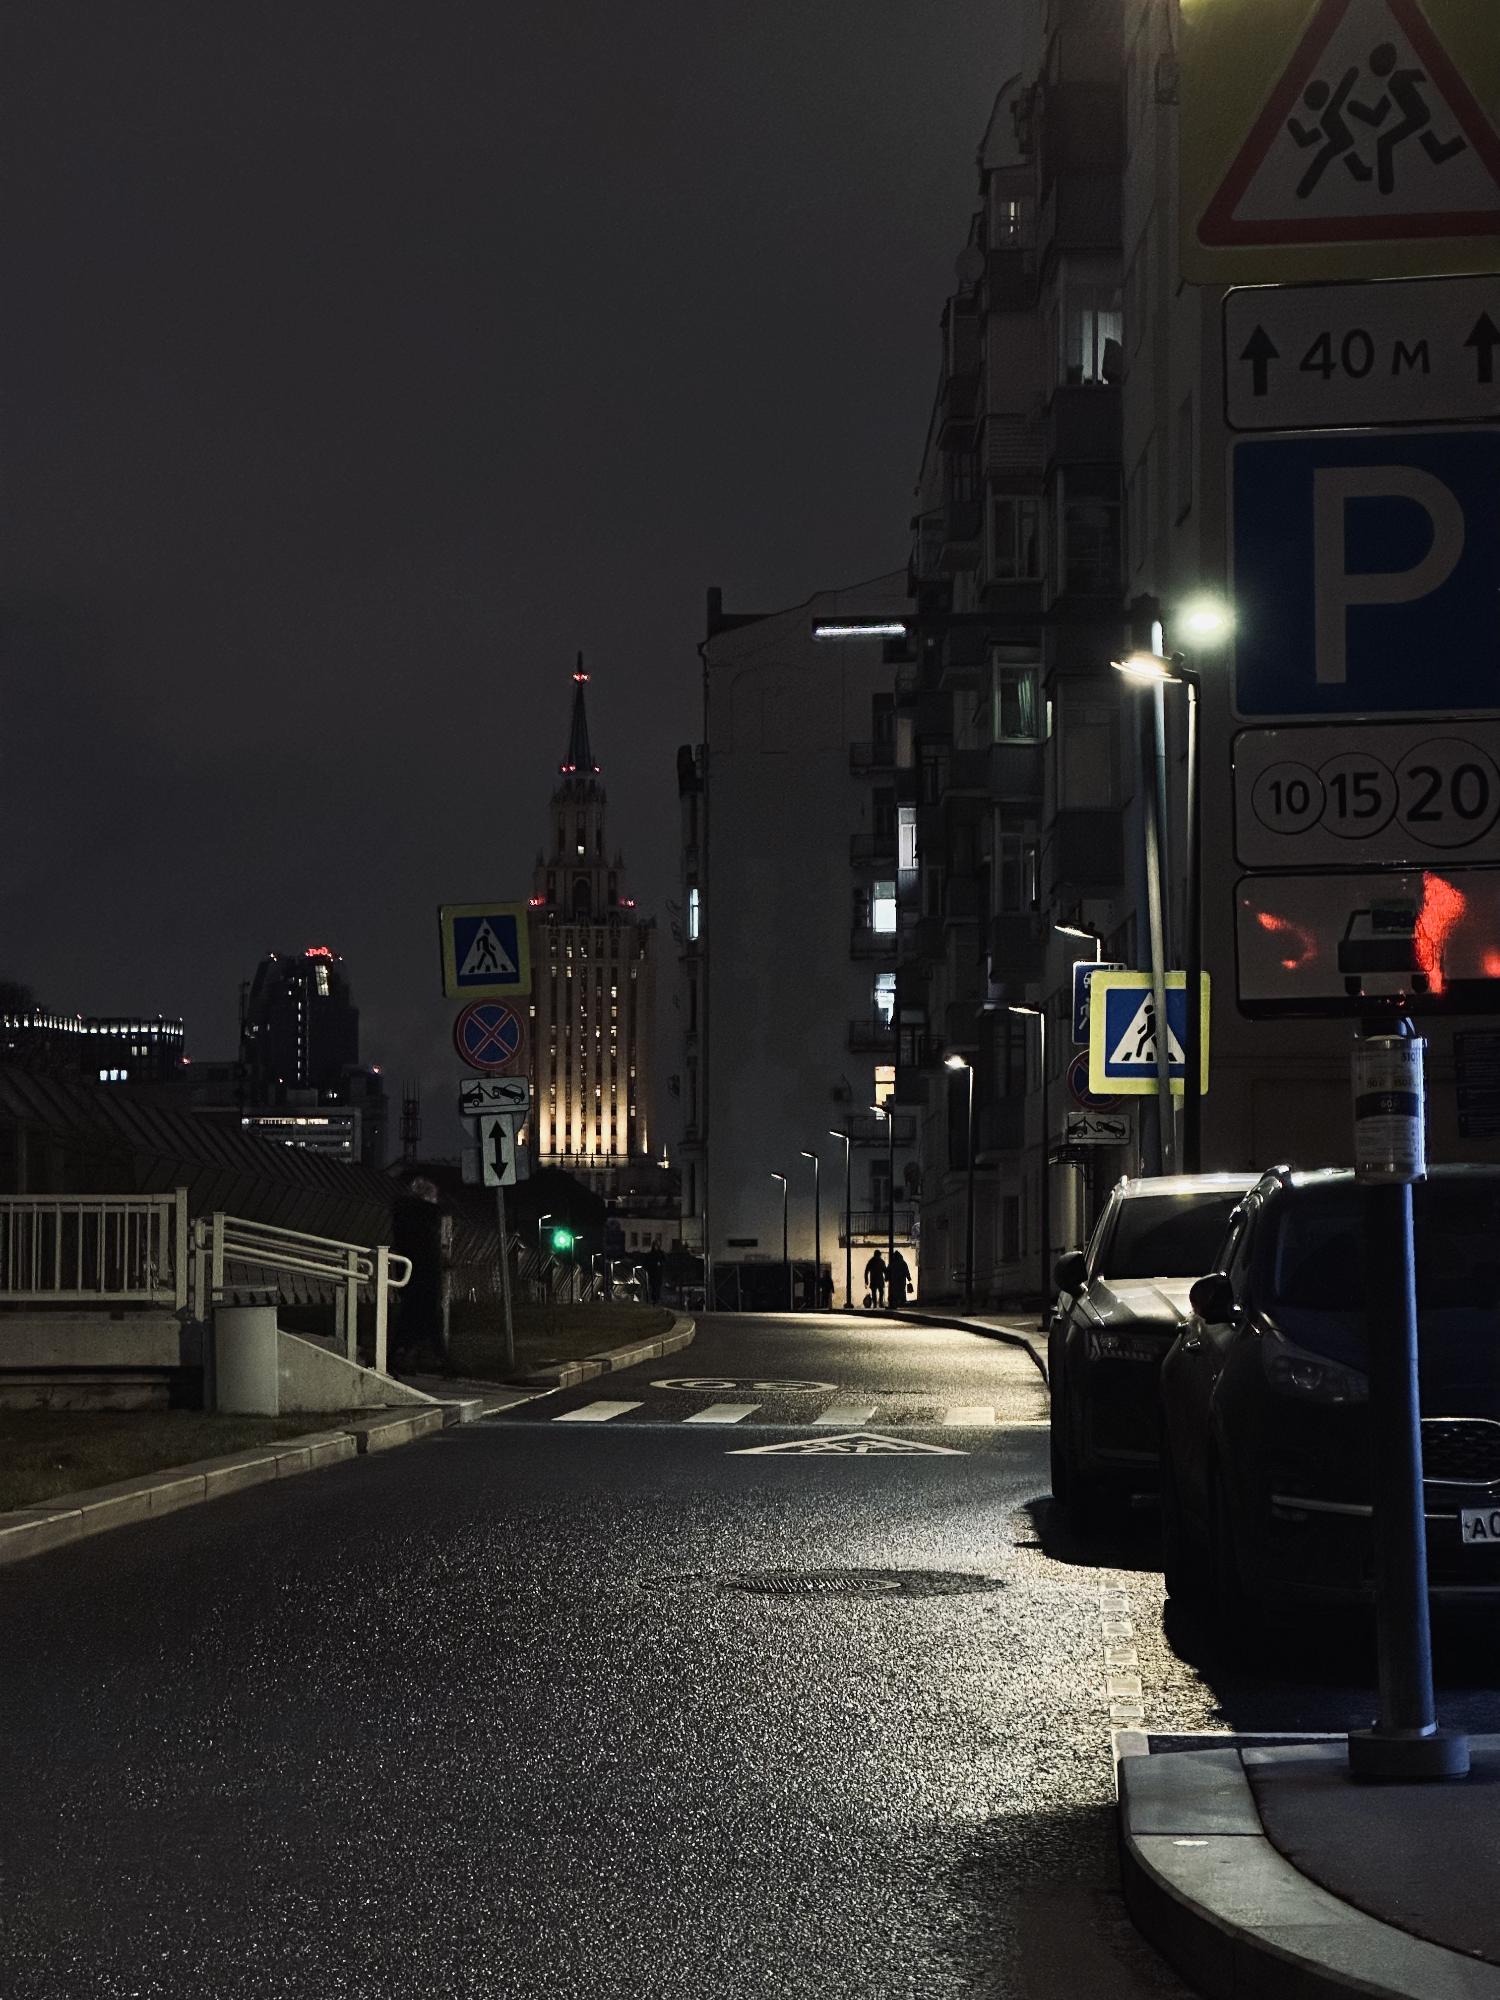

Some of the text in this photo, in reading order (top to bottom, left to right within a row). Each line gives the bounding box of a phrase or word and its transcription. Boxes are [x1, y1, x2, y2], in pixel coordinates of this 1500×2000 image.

[1300, 328, 1375, 380] 40
[1312, 463, 1466, 684] P
[1268, 762, 1490, 823] 10 15 20
